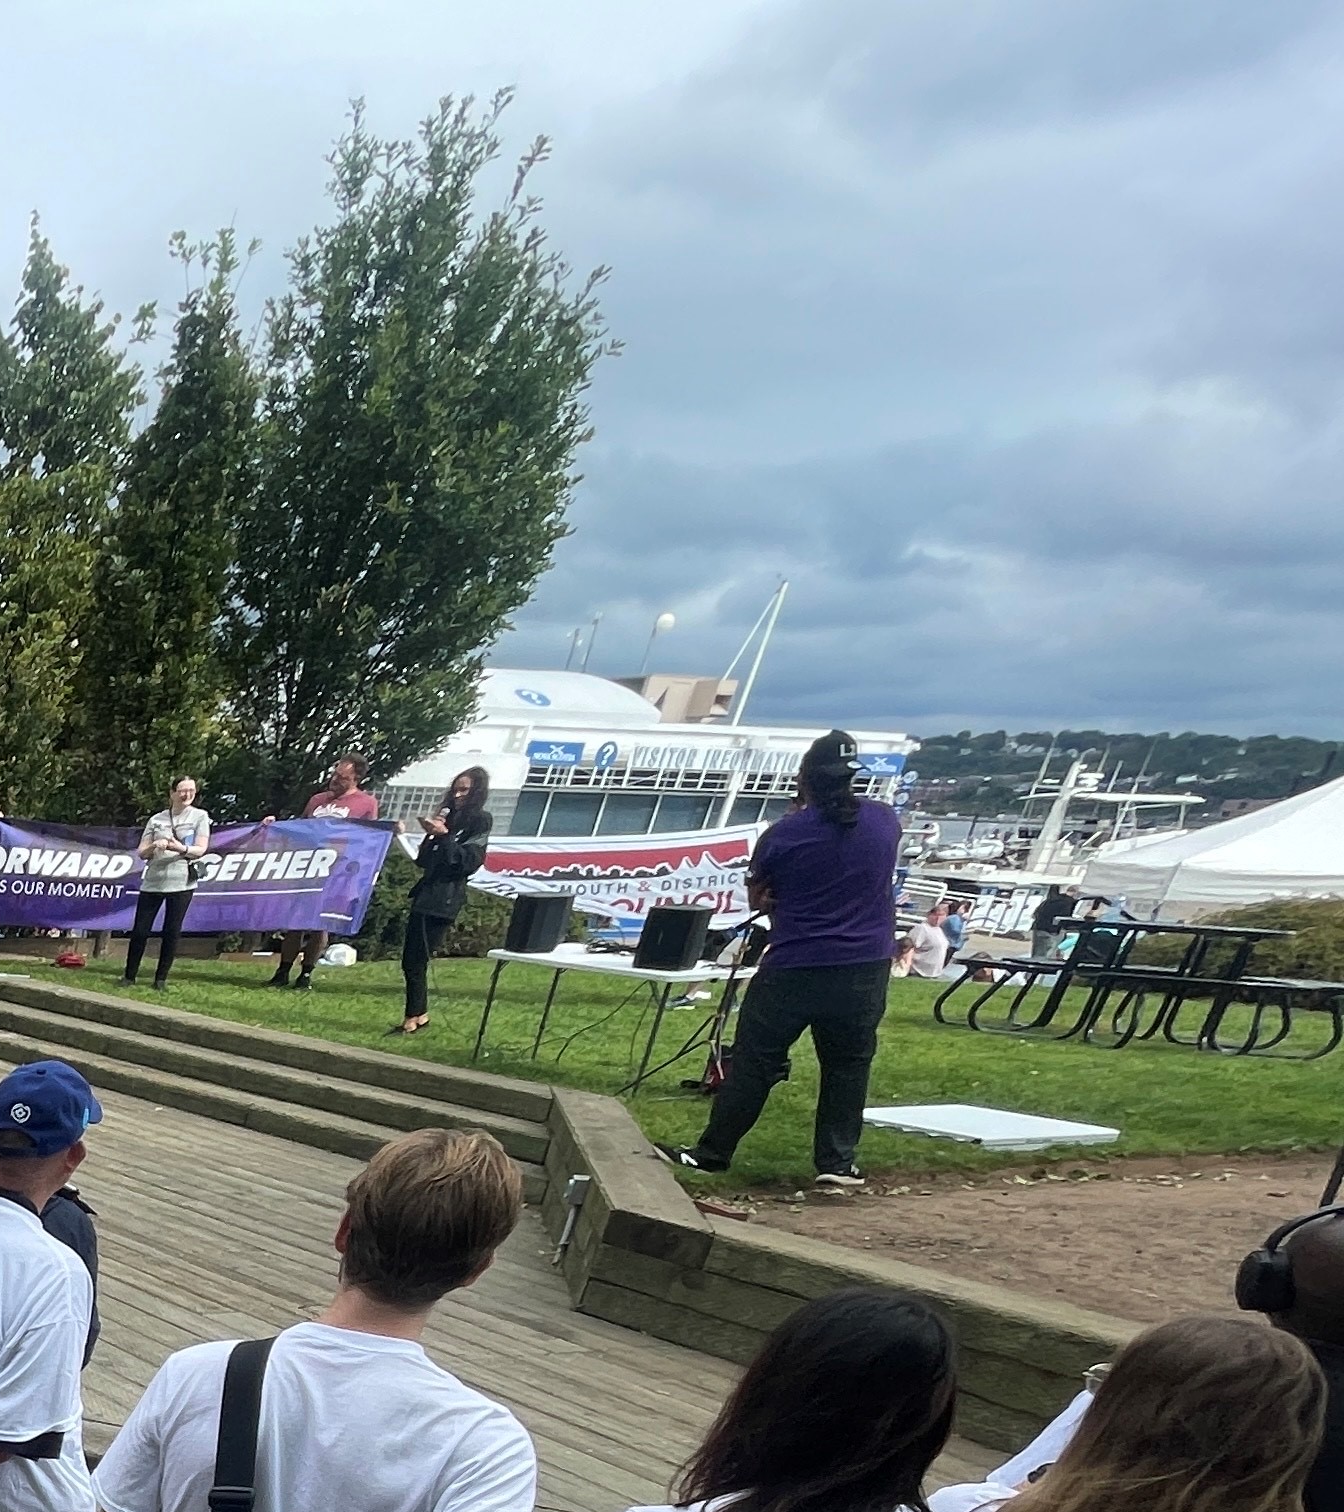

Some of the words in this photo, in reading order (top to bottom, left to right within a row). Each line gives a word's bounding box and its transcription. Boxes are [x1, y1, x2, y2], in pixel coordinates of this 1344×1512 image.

[702, 748, 800, 772] INFORMATIO
[141, 849, 338, 882] GETHER
[11, 880, 44, 896] OUR
[47, 882, 124, 899] MOMENT
